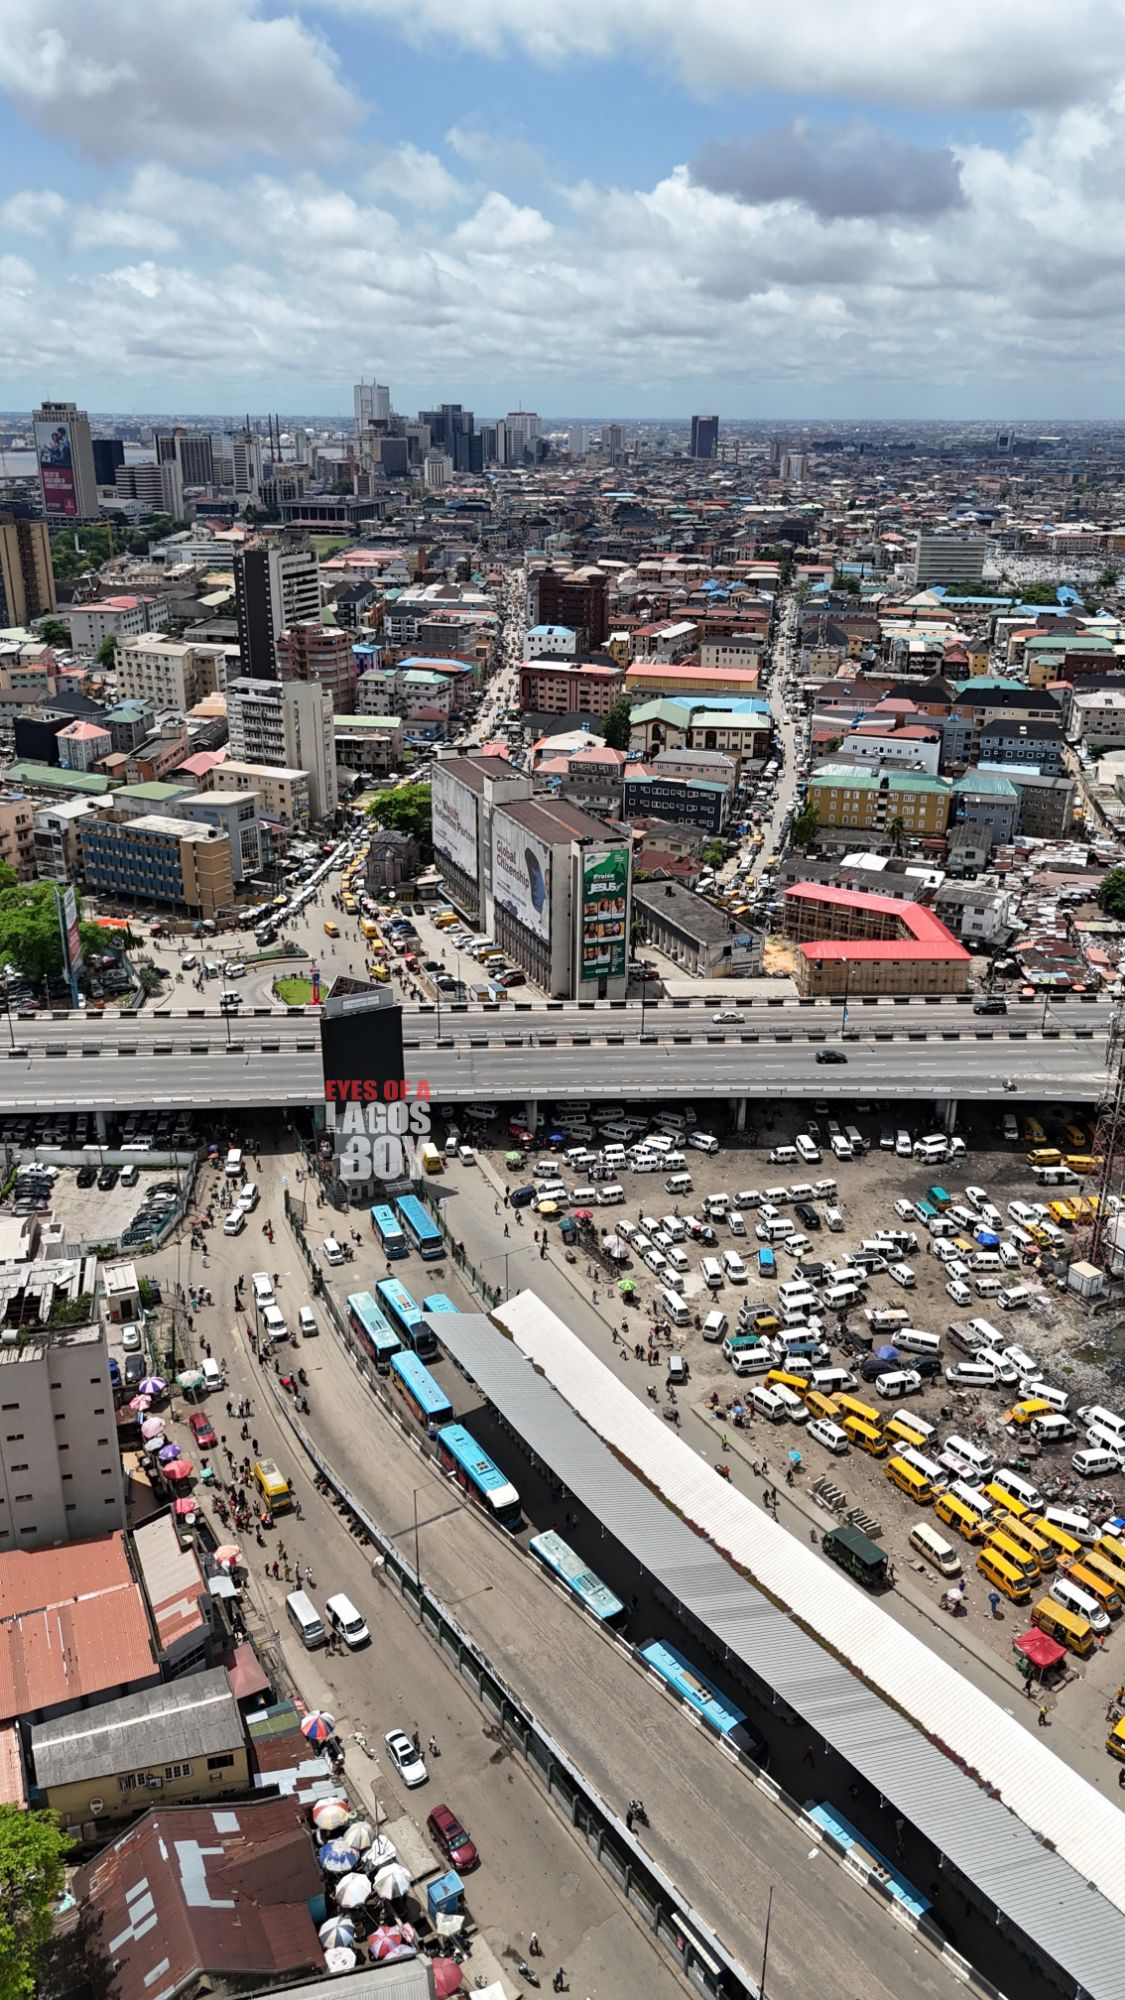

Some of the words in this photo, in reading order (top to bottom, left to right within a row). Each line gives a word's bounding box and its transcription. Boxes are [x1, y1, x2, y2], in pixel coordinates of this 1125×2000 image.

[496, 840, 516, 865] Global
[496, 853, 530, 890] Citizenship
[593, 872, 615, 880] Praise
[587, 882, 618, 895] JESUS
